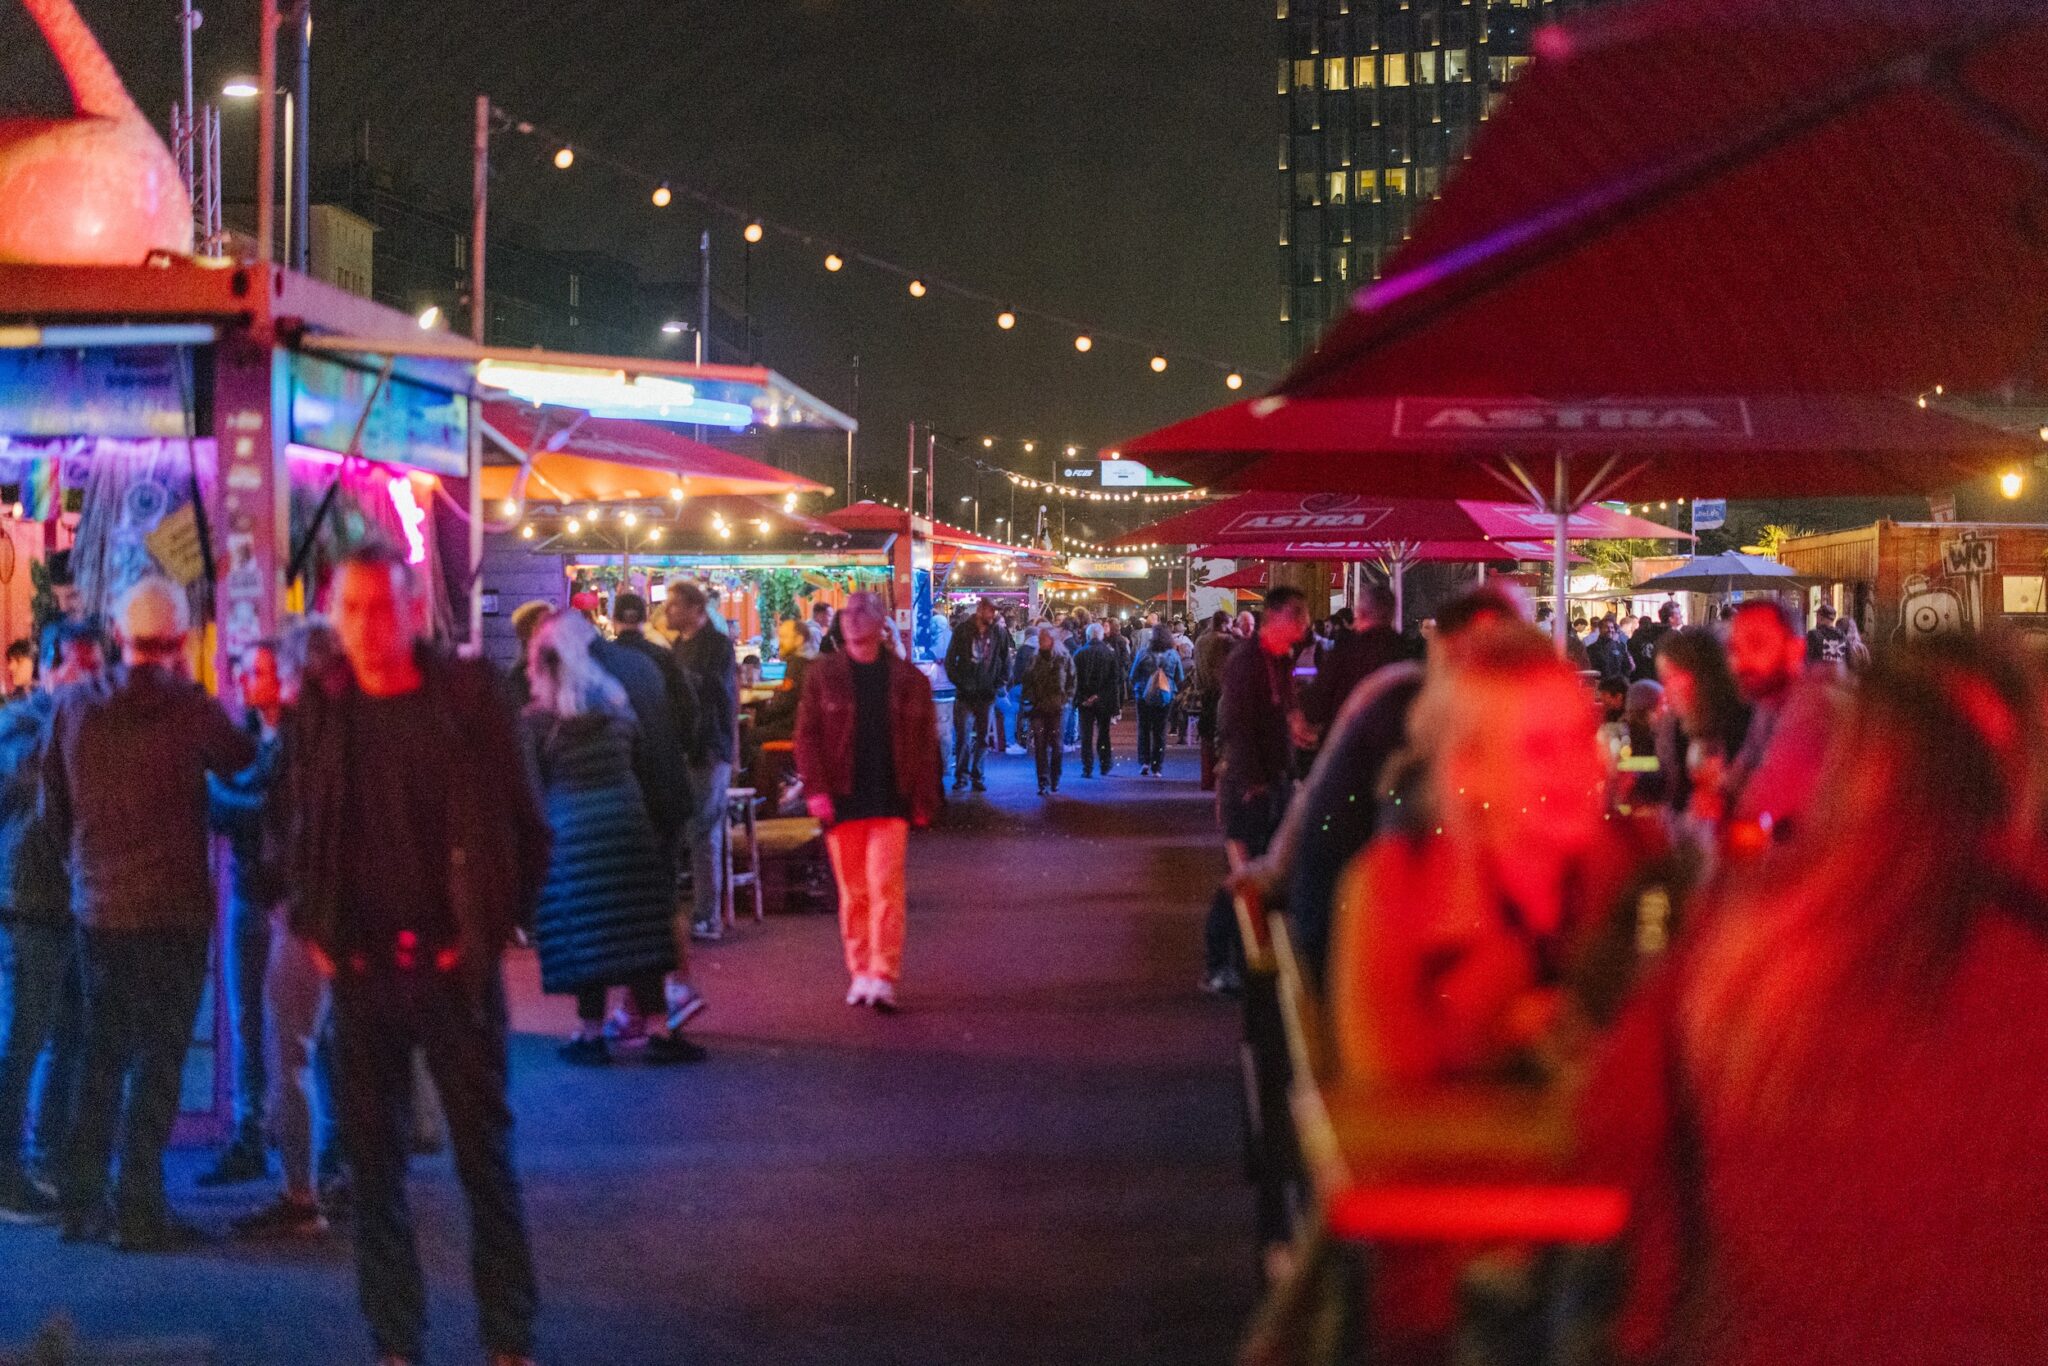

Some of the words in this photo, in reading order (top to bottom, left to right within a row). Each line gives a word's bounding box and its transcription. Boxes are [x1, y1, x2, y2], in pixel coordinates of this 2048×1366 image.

[1425, 408, 1720, 429] ASTRA
[1240, 514, 1366, 528] ASTRA
[1947, 541, 1988, 571] WC
